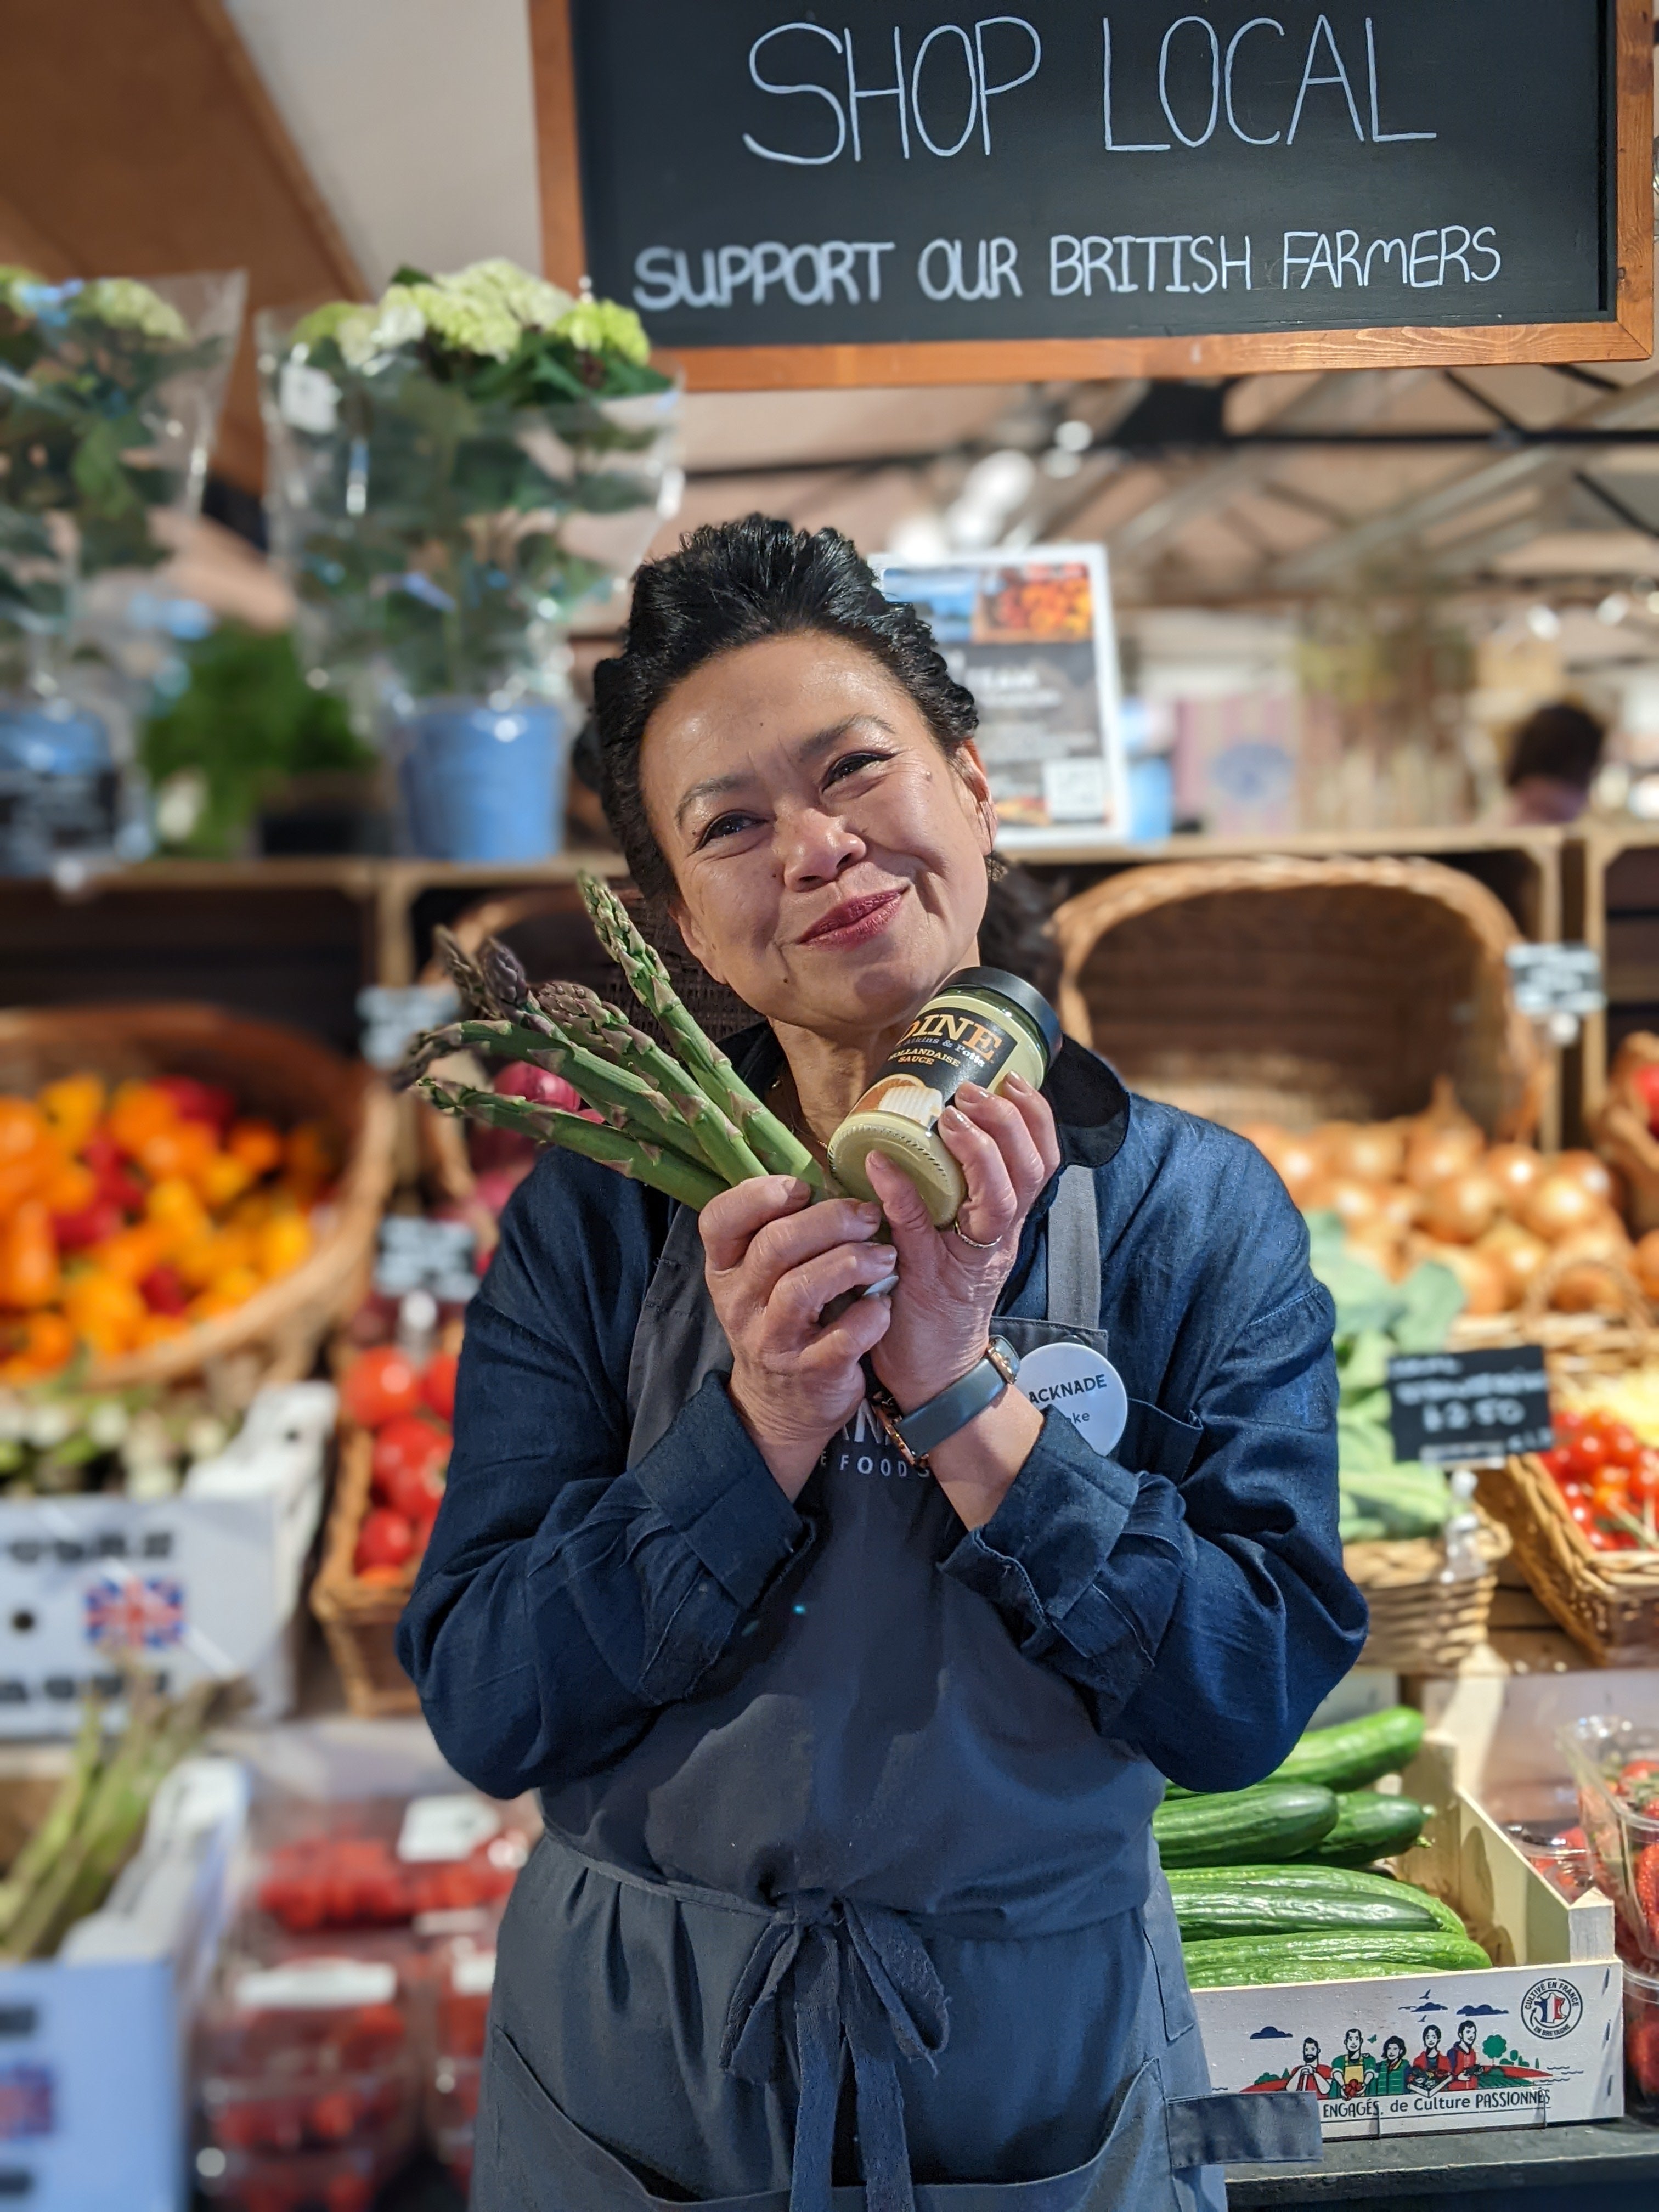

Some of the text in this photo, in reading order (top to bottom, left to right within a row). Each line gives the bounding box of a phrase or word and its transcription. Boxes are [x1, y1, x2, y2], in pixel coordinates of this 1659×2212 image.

[743, 14, 1437, 165] SHOP LOCAL
[633, 224, 1502, 312] SUPPORT OUR BRITISH FARMERS
[898, 1055, 935, 1065] SAUCE
[1558, 1983, 1580, 2007] FRANCE
[1390, 2099, 1408, 2112] de
[1414, 2096, 1470, 2111] Culture
[1476, 2086, 1551, 2109] PASSIONNÉS
